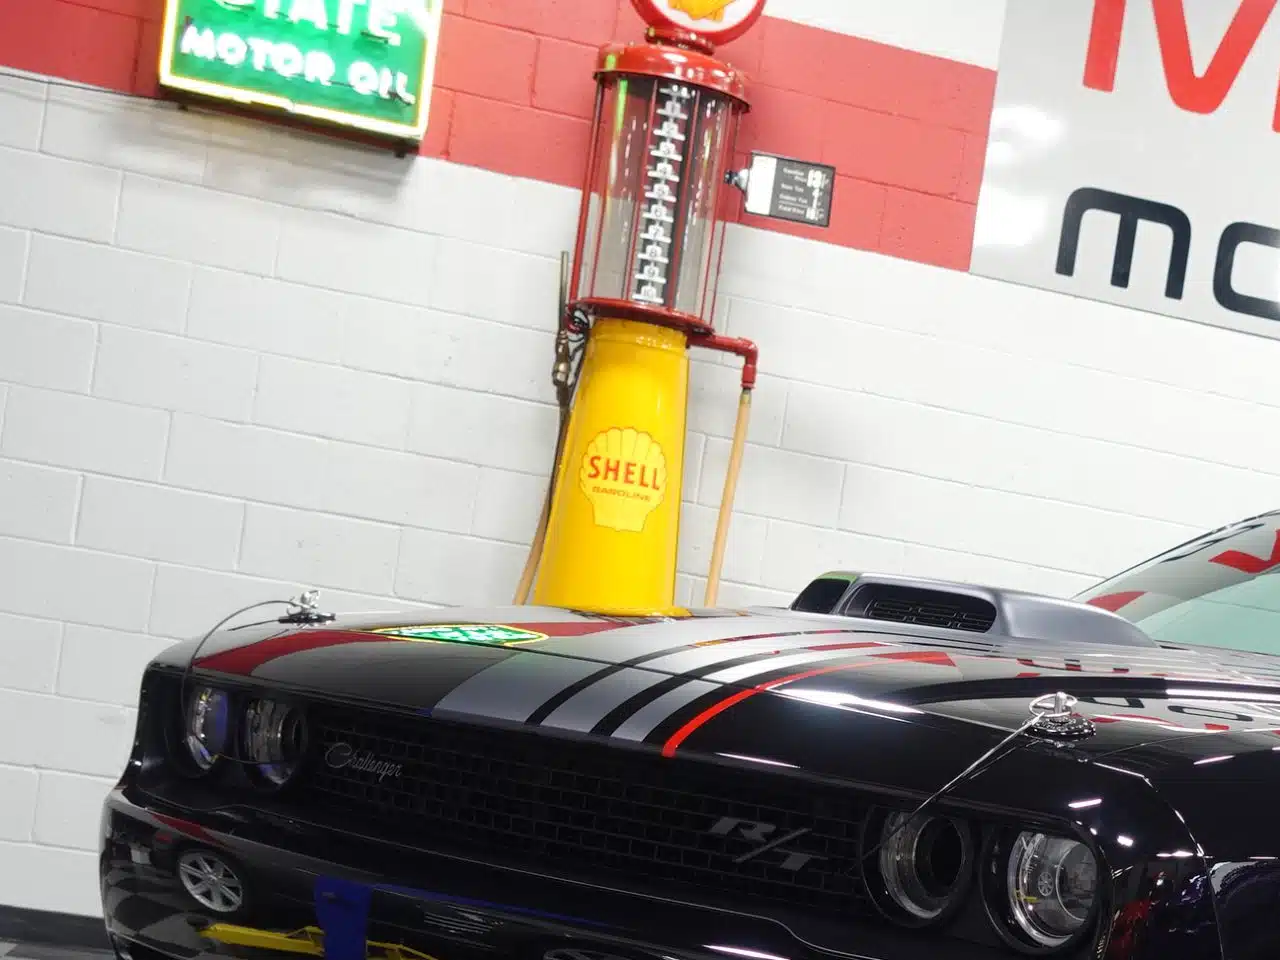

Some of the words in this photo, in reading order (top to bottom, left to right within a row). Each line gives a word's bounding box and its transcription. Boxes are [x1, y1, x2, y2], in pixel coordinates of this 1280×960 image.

[214, 0, 401, 46] ATE
[180, 24, 336, 86] MOTOR
[347, 60, 416, 105] OIL
[587, 455, 660, 491] SHELL
[324, 741, 403, 782] Challenger
[707, 816, 812, 872] R/T
